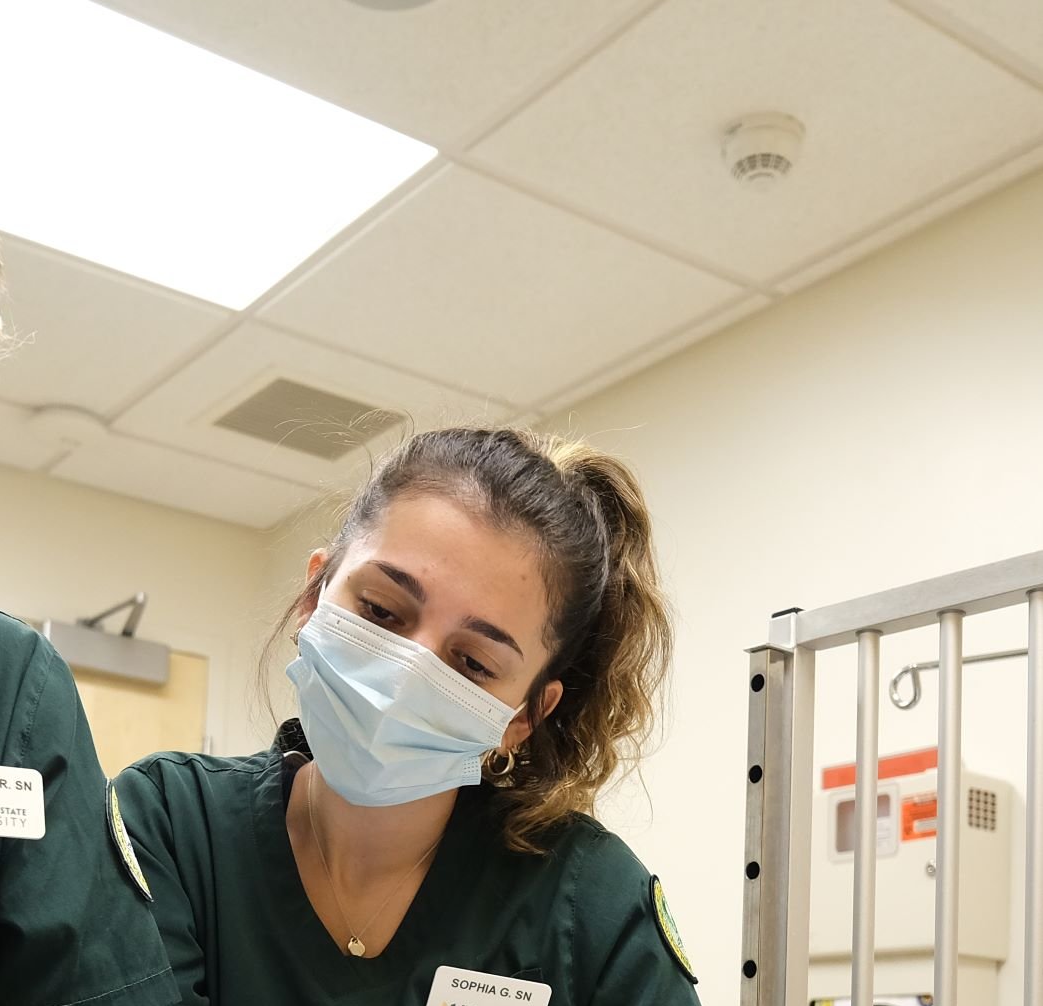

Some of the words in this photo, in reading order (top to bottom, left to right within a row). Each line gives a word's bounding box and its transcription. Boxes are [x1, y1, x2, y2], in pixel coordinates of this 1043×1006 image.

[0, 779, 11, 789] R.
[15, 780, 32, 791] SN
[0, 807, 27, 816] STATE
[451, 978, 496, 995] SOPHIA
[500, 987, 512, 998] G.
[515, 990, 532, 1002] SN
